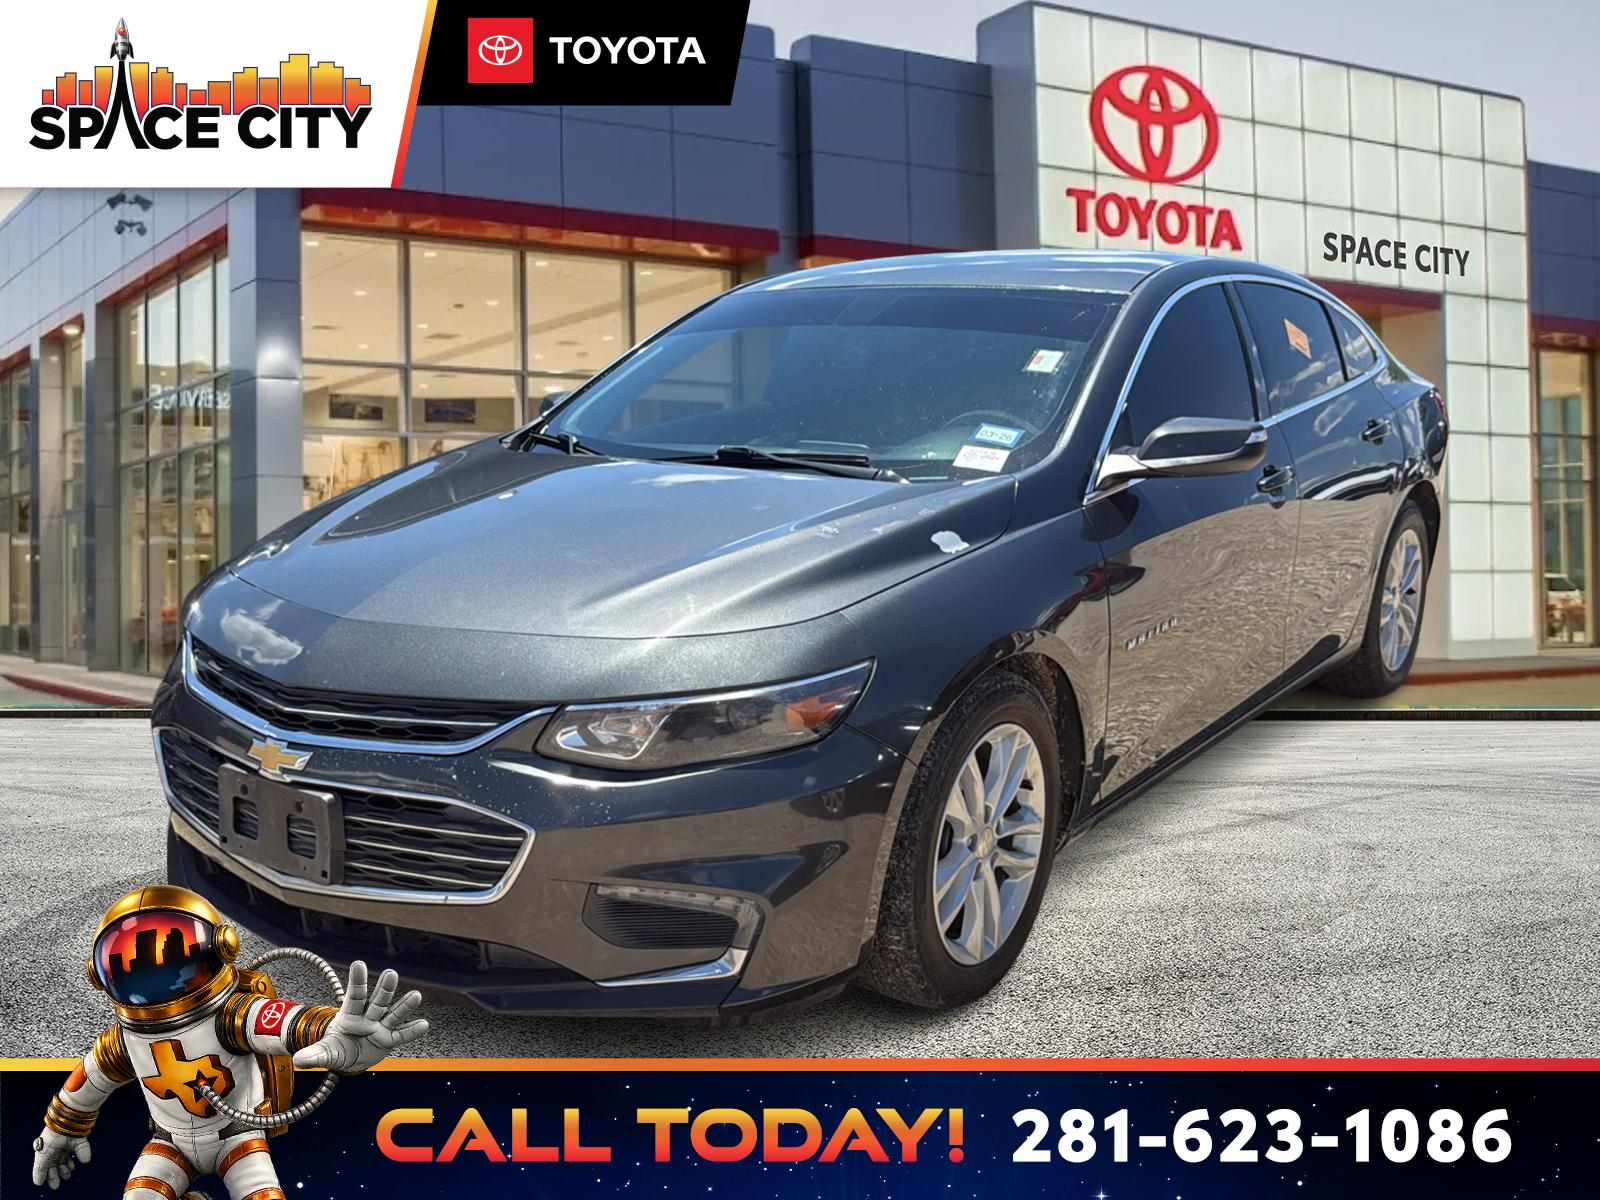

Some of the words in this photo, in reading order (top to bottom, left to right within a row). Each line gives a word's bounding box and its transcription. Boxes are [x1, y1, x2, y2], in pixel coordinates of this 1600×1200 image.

[1066, 187, 1242, 251] TOYOTA
[1322, 231, 1407, 270] SPACE
[1414, 244, 1470, 277] CITY
